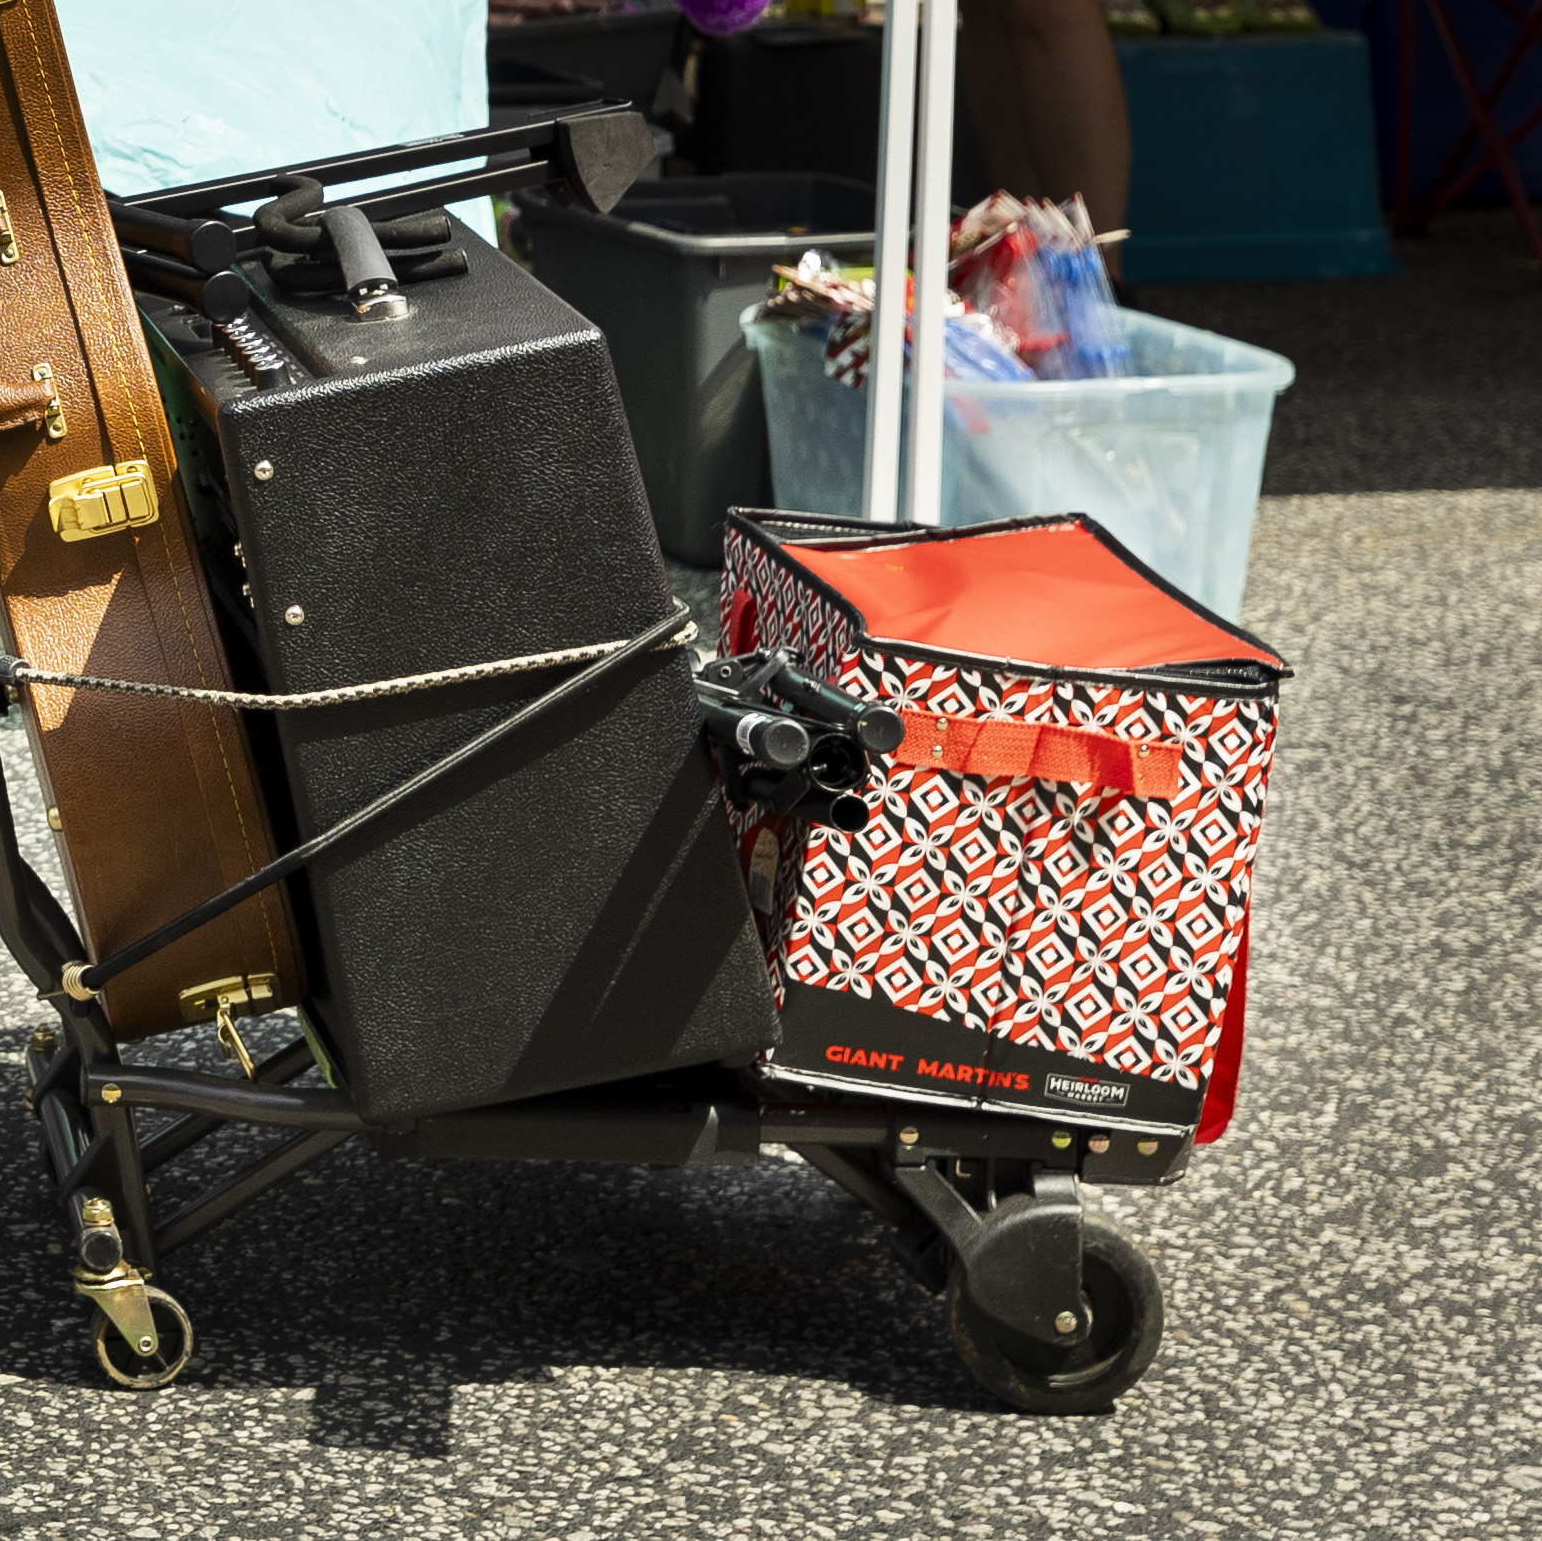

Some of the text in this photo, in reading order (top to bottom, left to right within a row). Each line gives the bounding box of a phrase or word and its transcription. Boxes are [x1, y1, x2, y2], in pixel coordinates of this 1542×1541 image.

[825, 1045, 1030, 1091] GIANT MARTIN'S
[1050, 1076, 1125, 1100] HEIRLOOM
